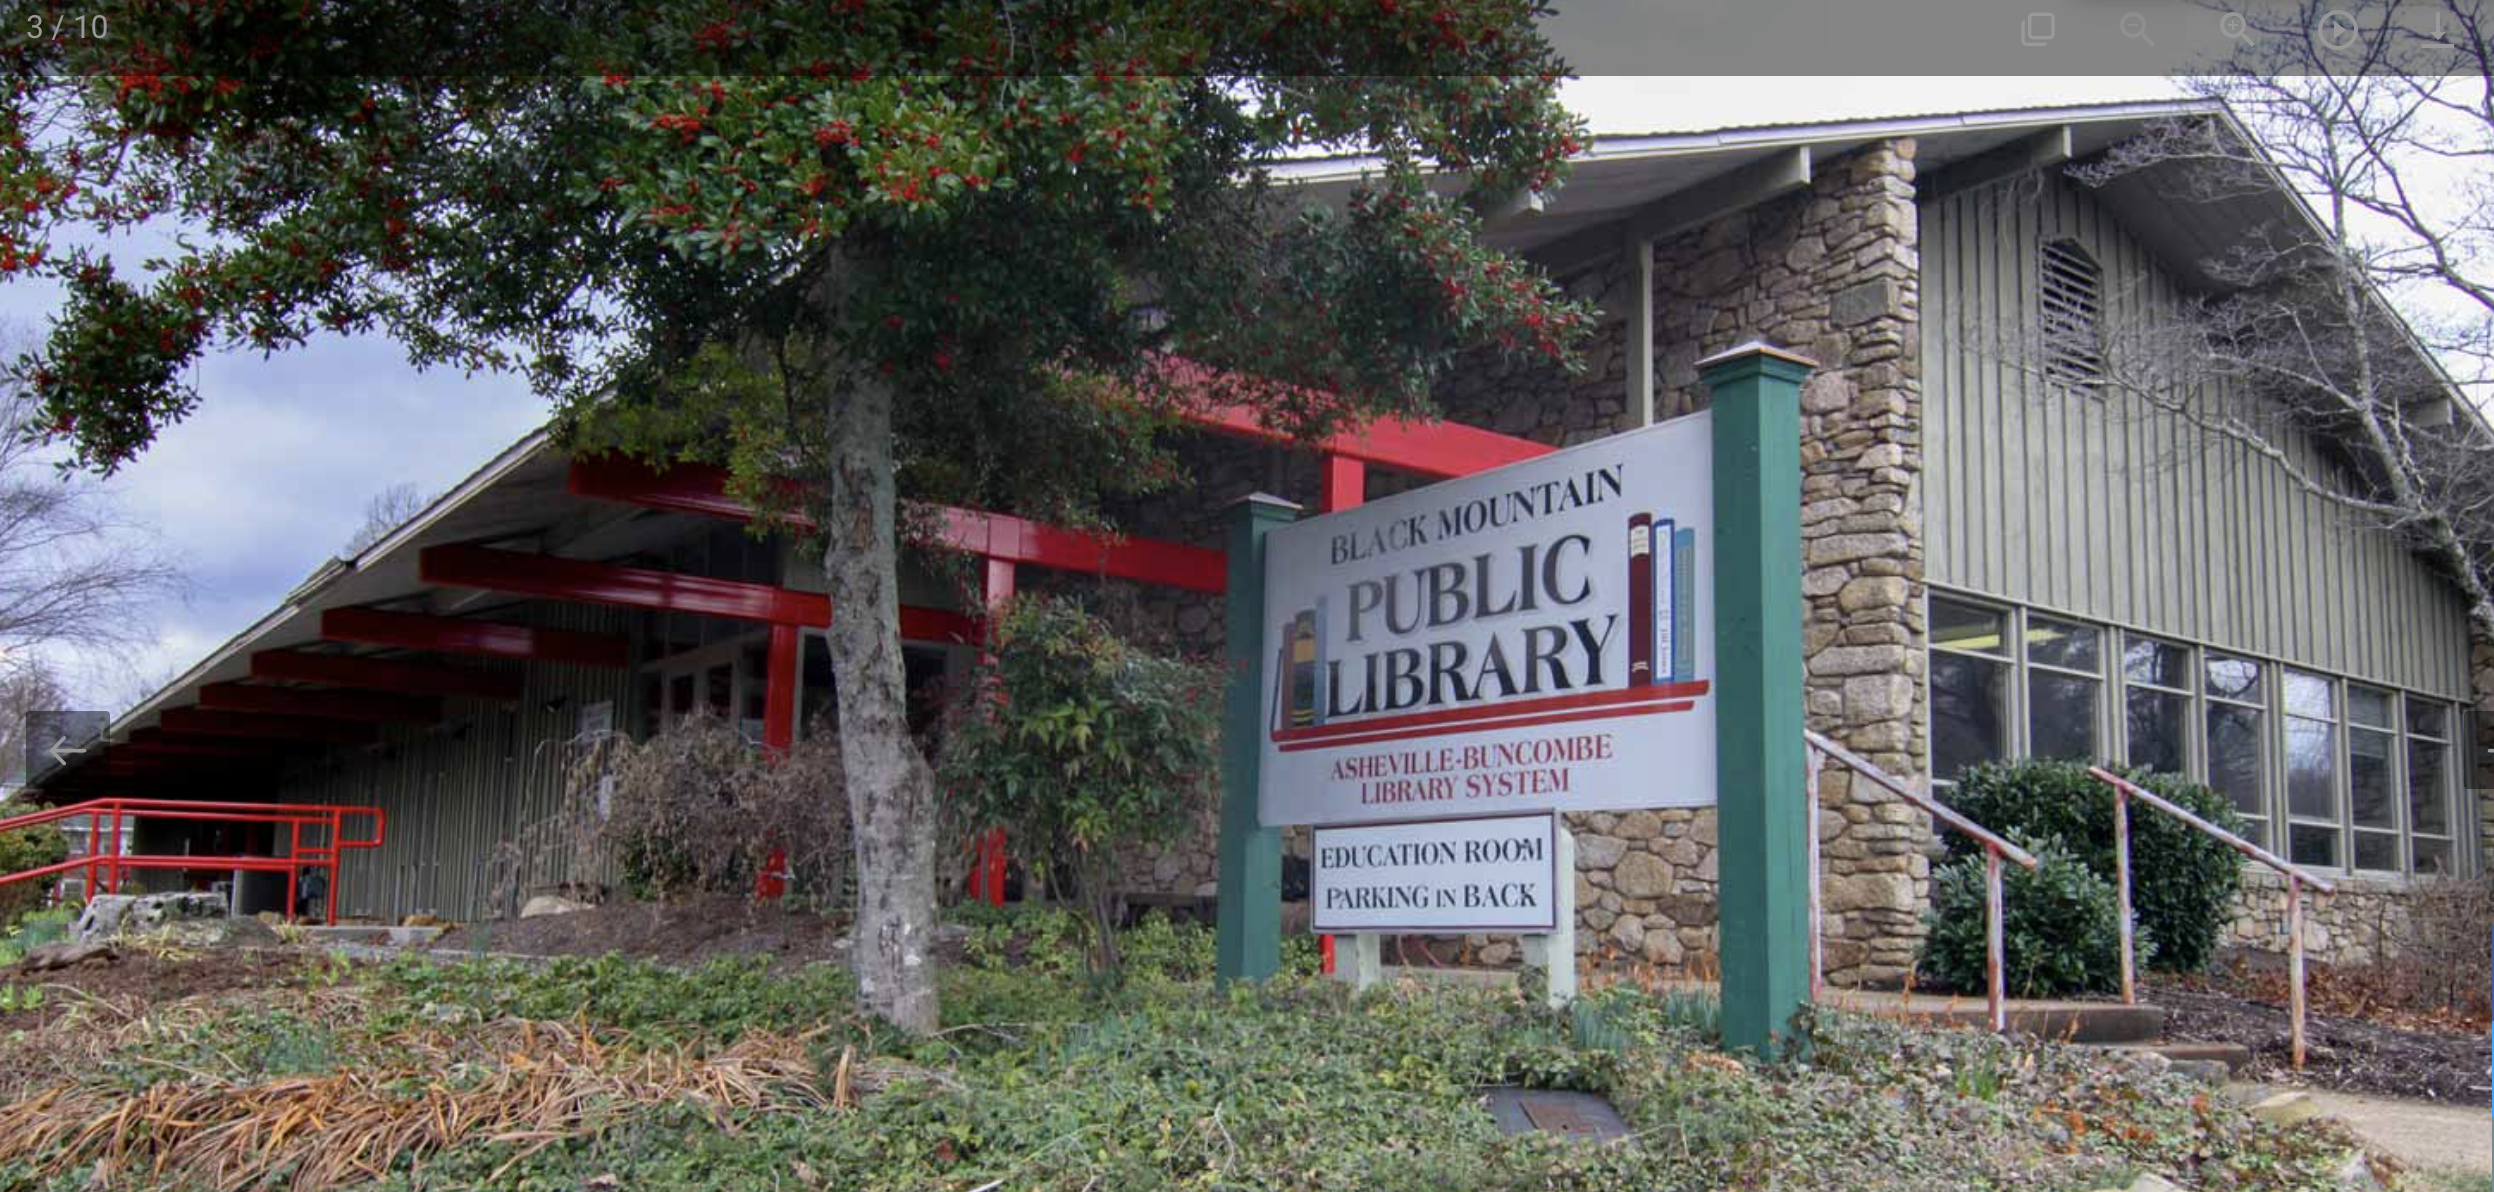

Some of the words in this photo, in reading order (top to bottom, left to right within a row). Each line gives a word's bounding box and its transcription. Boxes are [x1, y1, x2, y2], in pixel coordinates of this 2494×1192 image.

[1330, 514, 1428, 565] BLACK
[1437, 464, 1623, 541] MOUNTAIN
[1346, 534, 1592, 642] PUBLIC
[1327, 614, 1618, 718] LIBRARY
[1331, 734, 1613, 781] ASHEVILLE-BUNCOMBE
[1361, 776, 1458, 805] LIBRARY
[1465, 768, 1569, 798] SYSTEM
[1320, 841, 1456, 869] EDUCATION
[1465, 837, 1543, 864] ROOM
[1326, 885, 1429, 910] PARKING
[1436, 889, 1456, 908] IN
[1464, 883, 1537, 908] BACK
